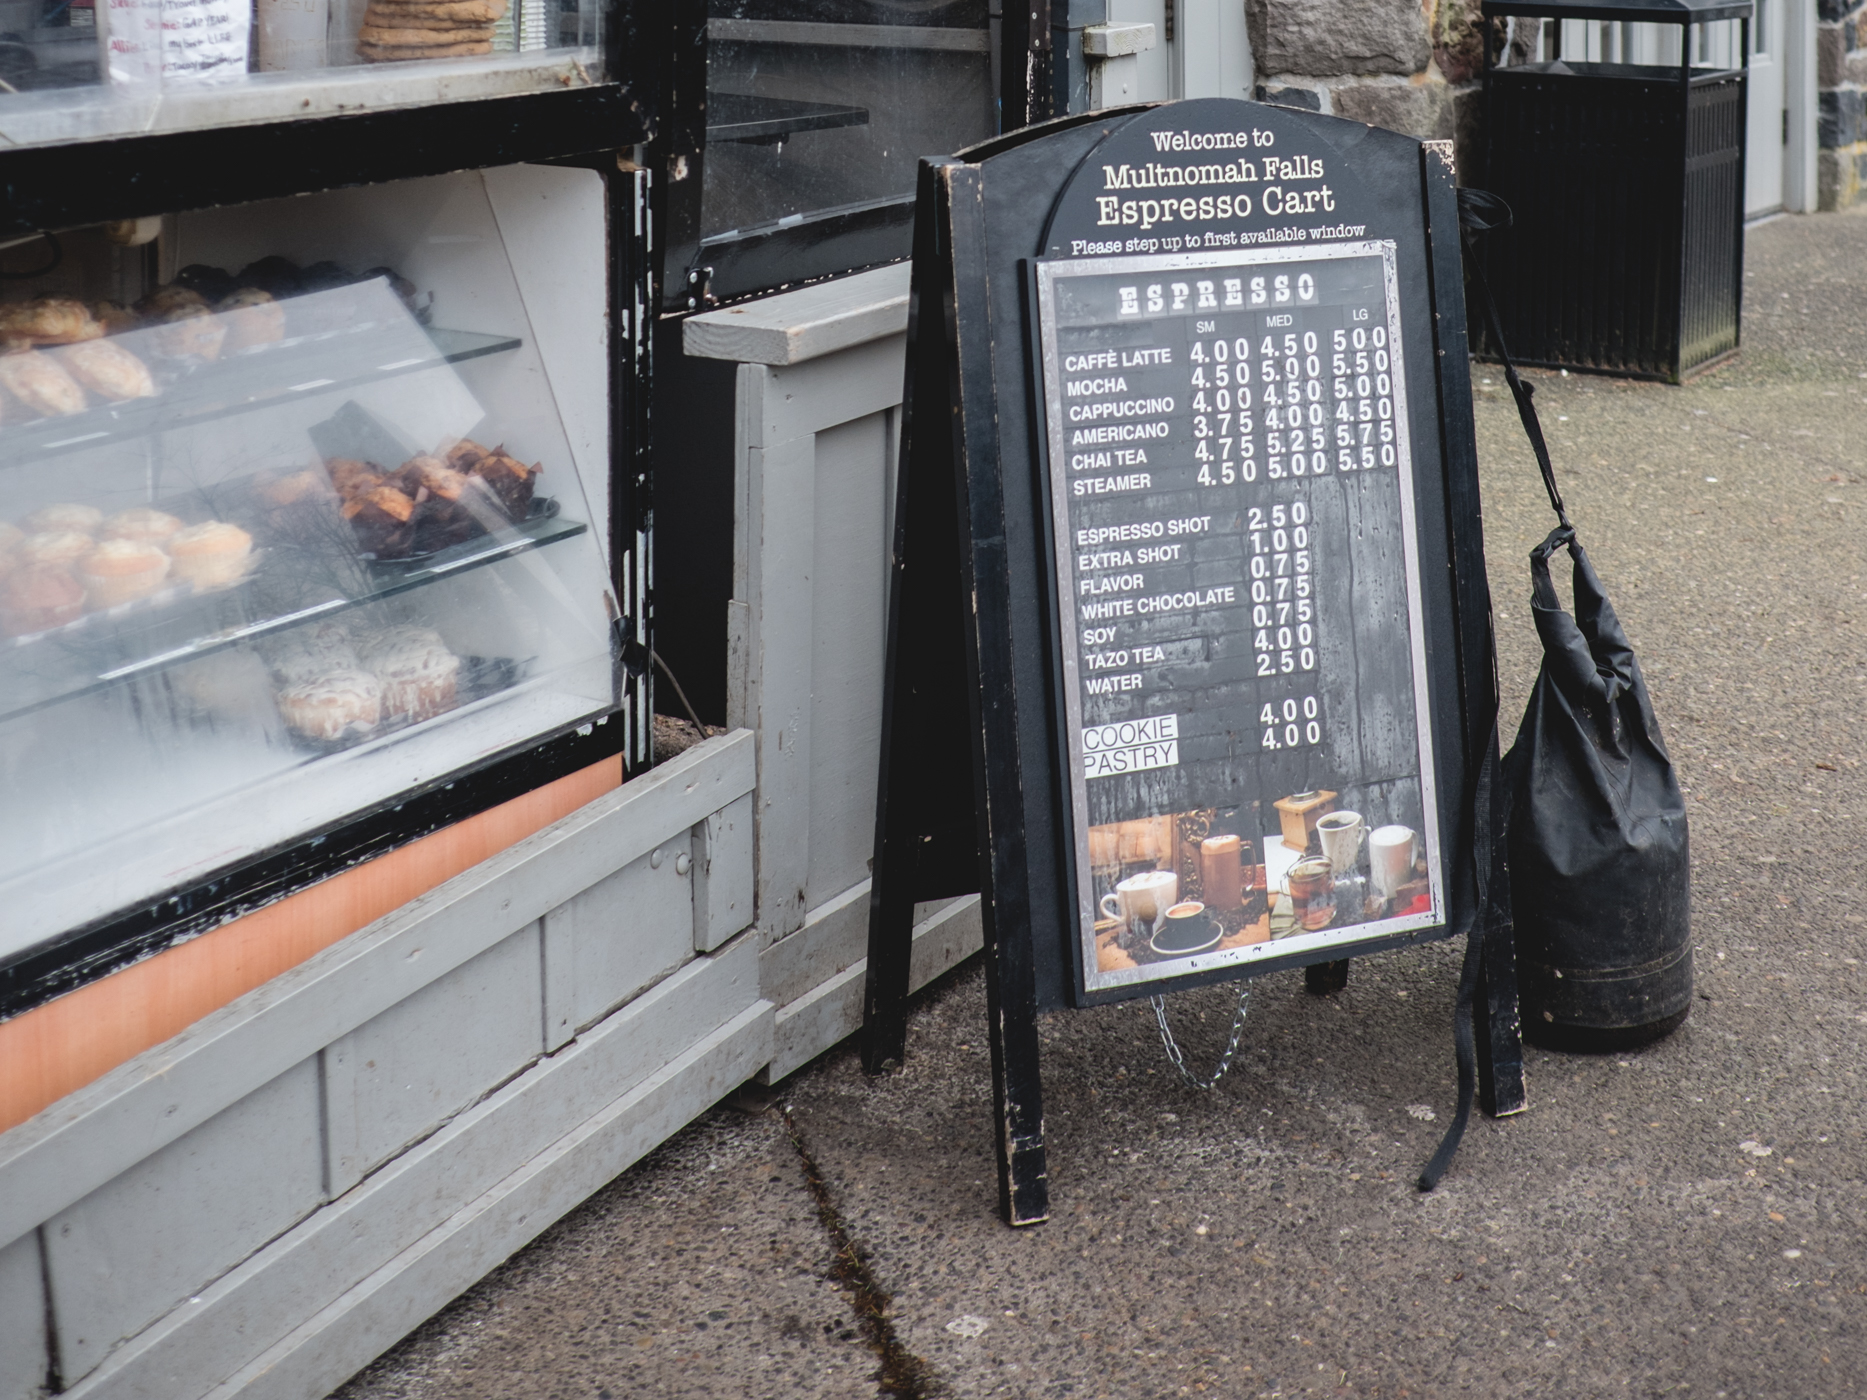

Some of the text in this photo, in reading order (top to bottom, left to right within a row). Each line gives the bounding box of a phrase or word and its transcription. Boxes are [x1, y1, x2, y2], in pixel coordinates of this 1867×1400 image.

[1151, 128, 1274, 151] Welcome to
[1102, 155, 1324, 190] Multnomah Falls
[1096, 185, 1335, 229] Espresso Cart
[1071, 223, 1366, 256] Please step up to first available window
[1119, 273, 1314, 314] ESPRESSO
[1196, 308, 1369, 333] SM MED LG
[1065, 349, 1118, 371] CAFFÈ
[1122, 348, 1172, 367] LATTE
[1190, 338, 1249, 364] 4.00
[1260, 331, 1318, 357] 4.50
[1067, 350, 1388, 397] MOCHA 4.50 5.00 5.50
[1069, 373, 1390, 422] CAPPUCCINO 4.00 4.50 5.00
[1072, 398, 1392, 446] AMERICANO 3.75 4.00 4.50
[1071, 420, 1393, 470] CHAI TEA 4.75 5.25 5.75
[1073, 444, 1395, 496] STEAMER 4.50 5.00 5.50
[1077, 502, 1306, 546] ESPRESSO SHOT 2.50
[1079, 526, 1308, 571] EXTRA SHOT 1.00
[1080, 551, 1310, 595] FLAVOR 0.75
[1082, 575, 1311, 620] WHITE CHOCOLATE 0.75
[1084, 599, 1312, 646] SOY 0.75
[1085, 623, 1312, 670] TAZO TEA 4.00
[1086, 647, 1315, 695] WATER 2.50
[1084, 696, 1318, 750] COOKIE 4.00
[1084, 721, 1321, 775] PASTRY 4.00
